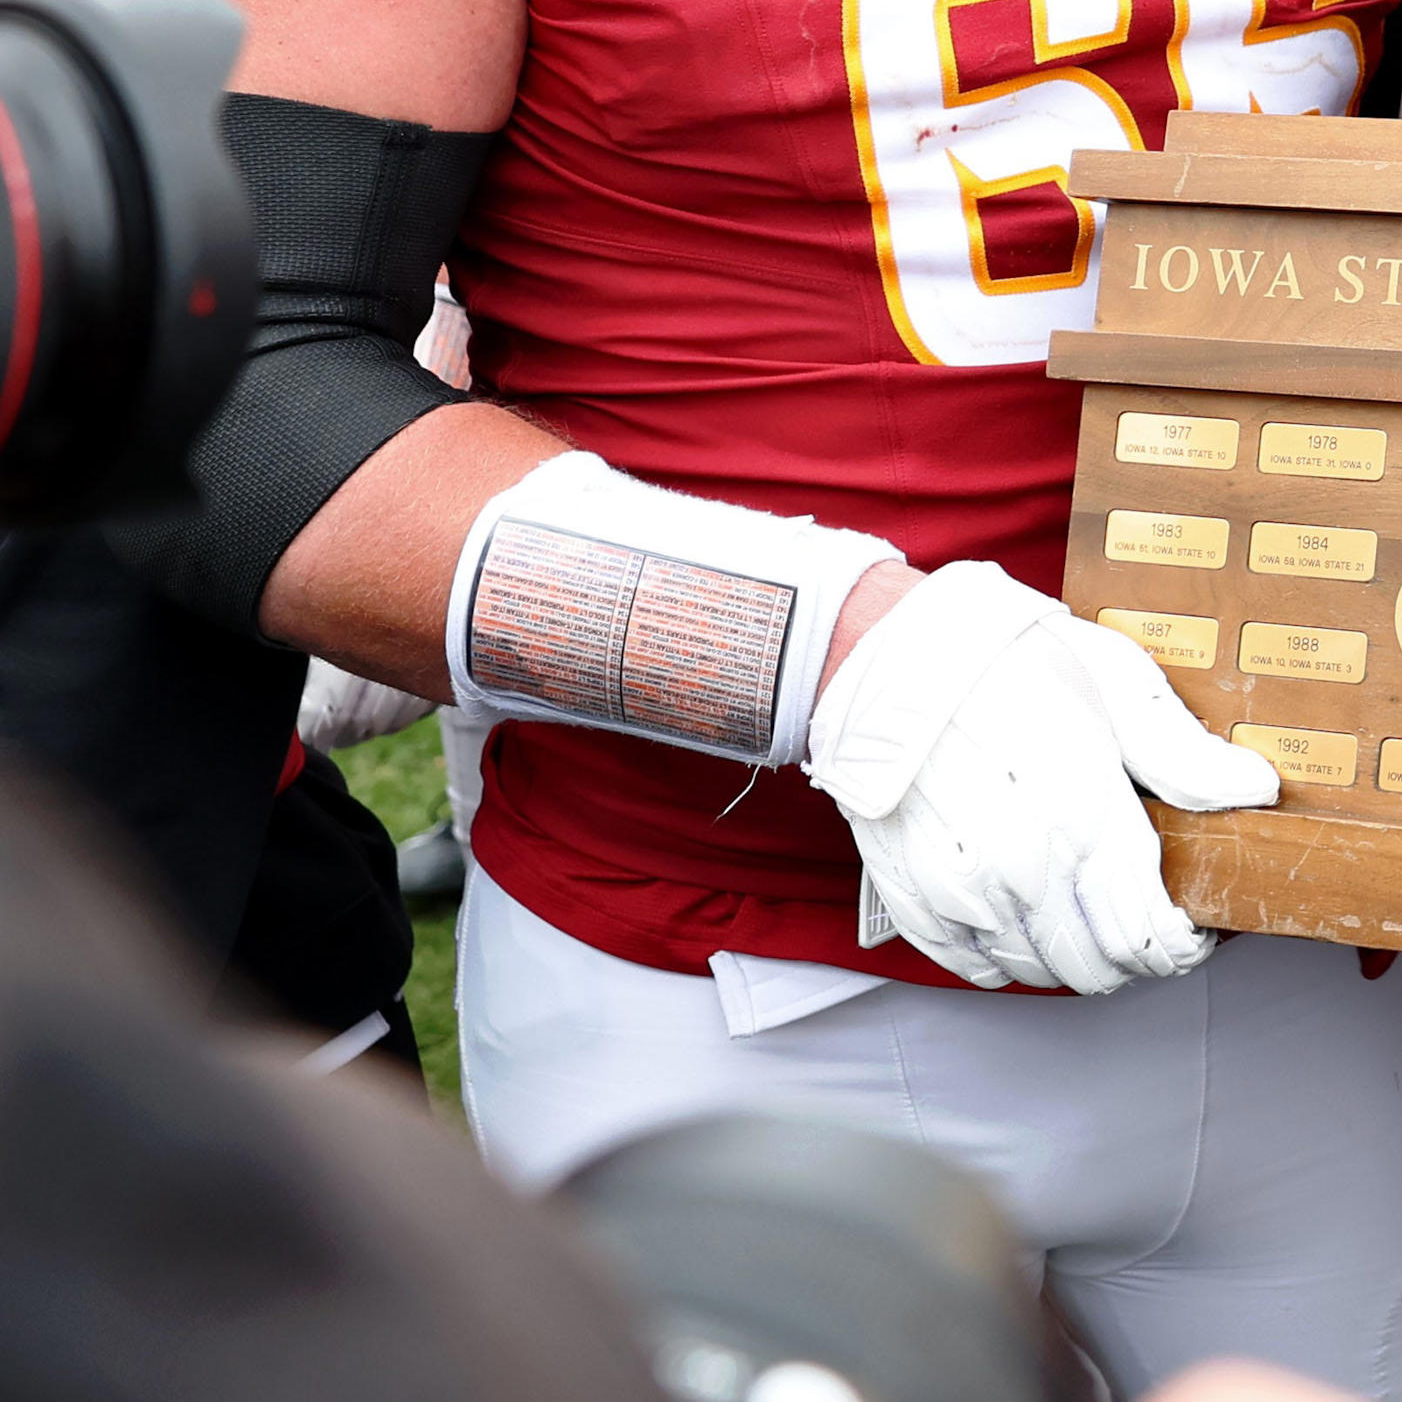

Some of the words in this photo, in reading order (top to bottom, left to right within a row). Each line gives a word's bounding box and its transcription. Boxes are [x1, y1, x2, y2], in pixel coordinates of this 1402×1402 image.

[1129, 241, 1306, 303] IOWA
[1164, 425, 1191, 439] 1977
[1308, 435, 1337, 450] 1978
[1125, 444, 1146, 454] IOWA
[1163, 447, 1184, 457] IOWA
[1187, 448, 1213, 459] STATE
[1217, 451, 1226, 460] 10
[1271, 455, 1292, 465] IOWA
[1296, 457, 1321, 467] STATE
[1340, 459, 1362, 469] IOWA
[1366, 461, 1371, 470] 0
[1152, 523, 1182, 539] 1983
[1115, 542, 1136, 552] IOWA
[1152, 545, 1173, 555] IOWA
[1177, 547, 1203, 558] STATE
[1207, 550, 1216, 559] 10
[1297, 536, 1328, 551] 1984
[1259, 555, 1280, 565] IOWA
[1299, 558, 1320, 568] IOWA
[1325, 560, 1351, 571] STATE
[1355, 562, 1364, 571] 21
[1142, 622, 1171, 638] 1987
[1287, 636, 1319, 652] 1988
[1169, 647, 1195, 658] STATE
[1250, 655, 1272, 665] IOWA
[1289, 659, 1311, 670] IOWA
[1315, 661, 1342, 672] STATE
[1346, 664, 1351, 673] 3
[1278, 738, 1309, 754] 1992
[1280, 761, 1301, 771] IOWA
[1306, 764, 1333, 775] STATE
[1337, 767, 1342, 776] 7
